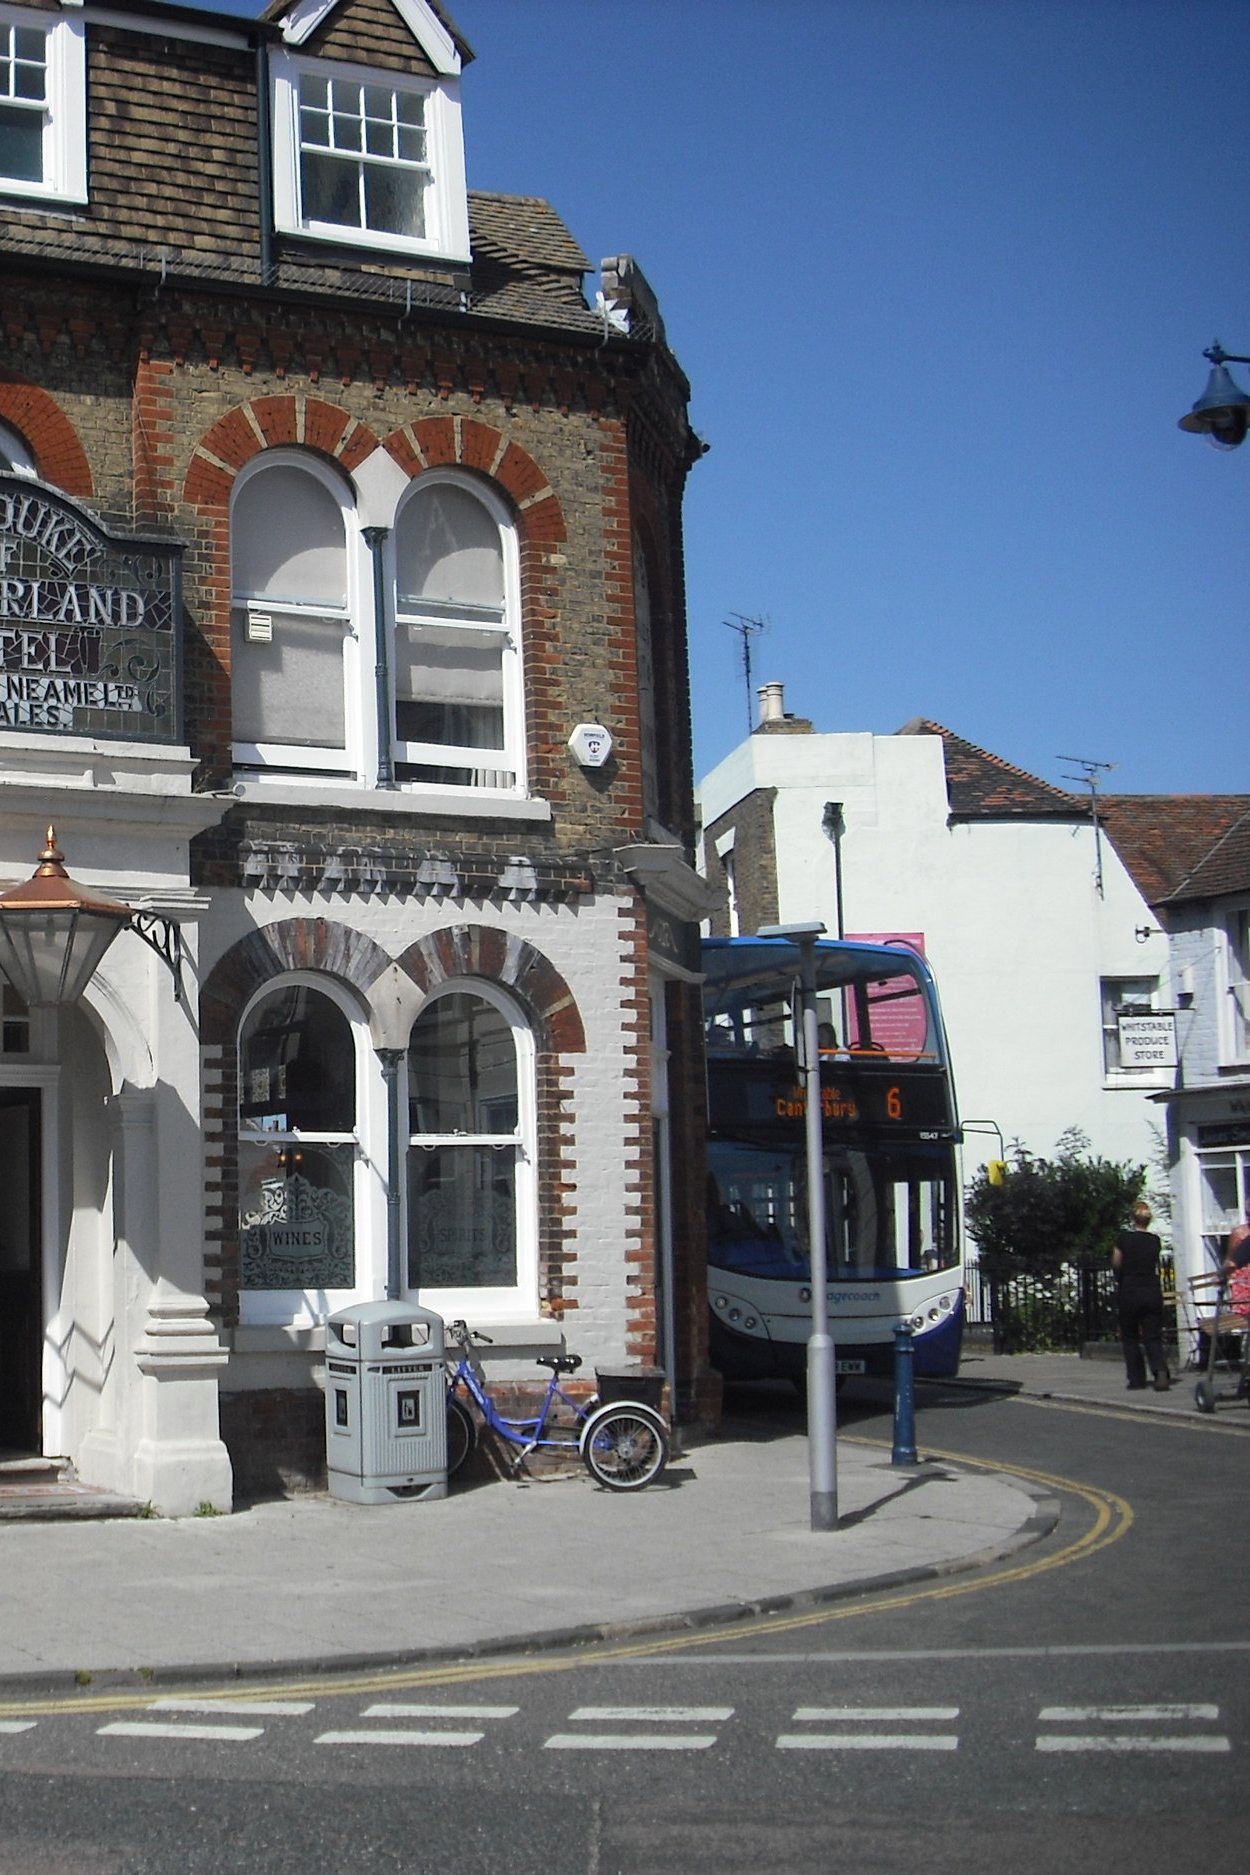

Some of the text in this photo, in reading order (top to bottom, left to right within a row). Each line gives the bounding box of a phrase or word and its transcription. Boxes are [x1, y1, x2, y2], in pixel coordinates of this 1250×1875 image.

[6, 674, 97, 706] NEAME
[1121, 1022, 1174, 1032] WHITSTABLE
[1125, 1036, 1170, 1046] PRODUCE
[1134, 1050, 1165, 1060] STORE
[886, 1087, 902, 1119] 6
[271, 1231, 322, 1246] WINES
[390, 1364, 424, 1374] LITTER
